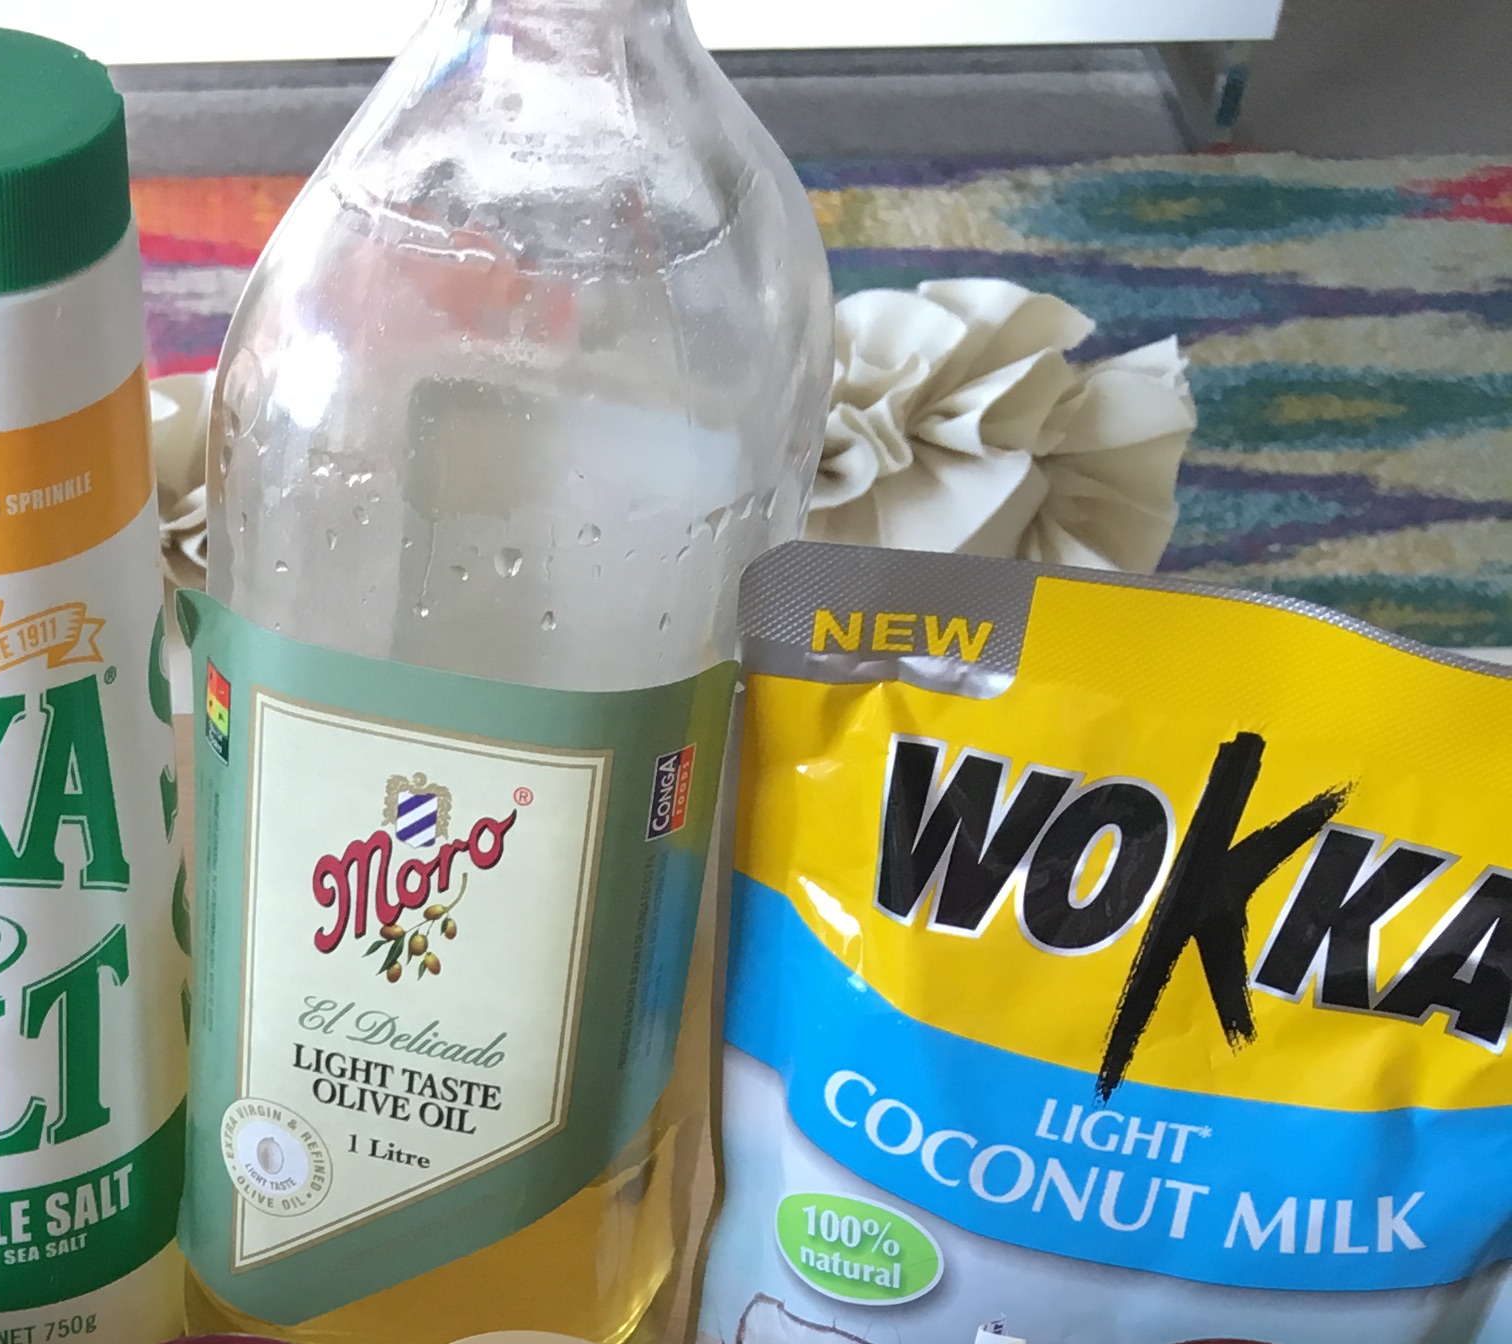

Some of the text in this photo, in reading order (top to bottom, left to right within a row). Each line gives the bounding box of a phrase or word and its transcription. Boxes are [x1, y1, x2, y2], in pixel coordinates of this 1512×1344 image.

[6, 470, 92, 515] SPRINKLE
[18, 618, 57, 650] 1911
[811, 608, 993, 663] NEW
[652, 755, 678, 831] CONGA
[312, 809, 518, 954] Moro
[872, 730, 1512, 1100] WOKKA
[297, 995, 508, 1069] El Delicado
[291, 1043, 502, 1112] LIGHT TASTE
[312, 1079, 477, 1135] OLIVE OIL
[224, 1104, 326, 1192] EXTRA VIRGIN & REFINED
[347, 1134, 431, 1169] 1 Litre
[823, 1069, 1427, 1256] COCONUT MILK
[47, 1163, 134, 1237] SALT
[237, 1175, 306, 1210] OLIVE OIL
[245, 1163, 297, 1191] LIGHT TASTE
[4, 1249, 39, 1266] SEA
[46, 1233, 87, 1258] SALT
[800, 1203, 900, 1260] 100%
[799, 1240, 902, 1291] natural
[44, 1314, 98, 1342] 750g
